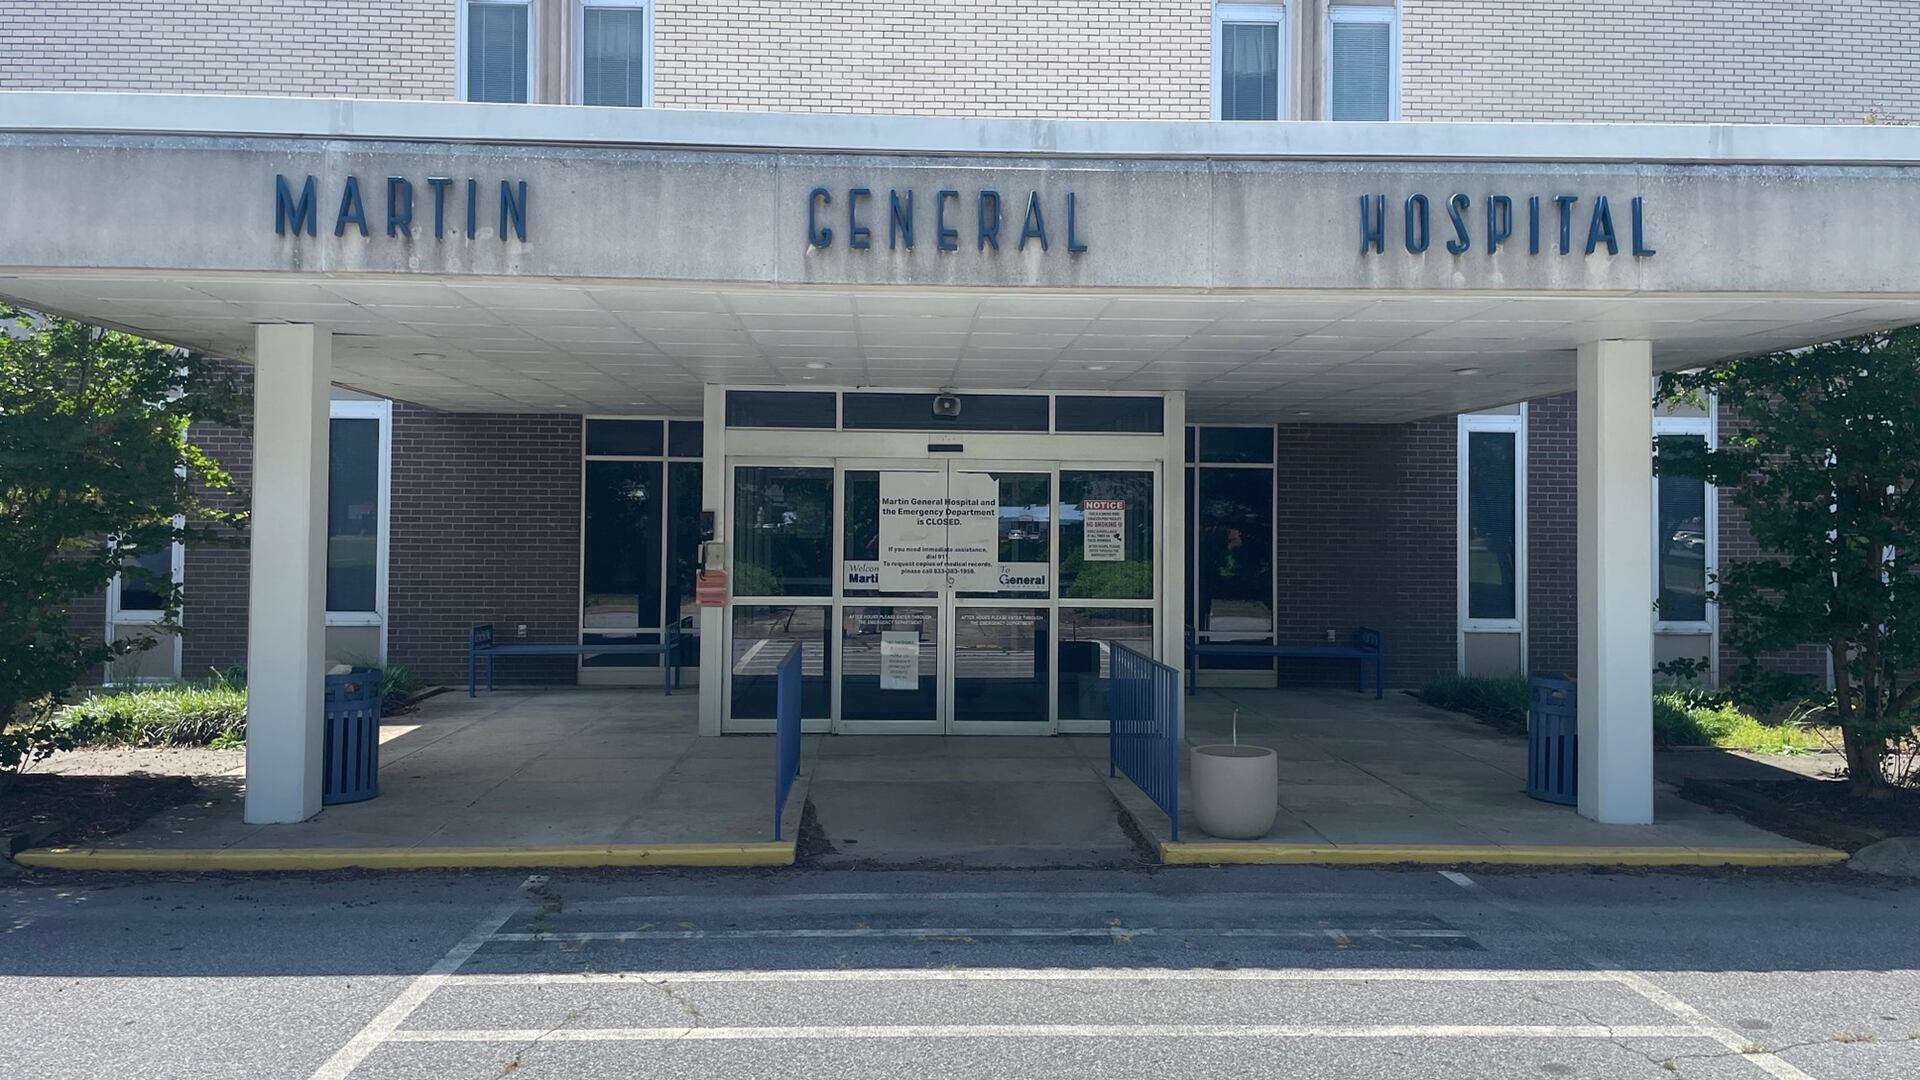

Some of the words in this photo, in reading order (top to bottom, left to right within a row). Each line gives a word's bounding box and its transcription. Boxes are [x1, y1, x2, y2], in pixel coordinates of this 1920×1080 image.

[275, 173, 527, 243] MARTIN
[808, 187, 1088, 253] GENERAL
[1360, 192, 1656, 256] HOSPITAL
[944, 499, 979, 507] Hospital
[898, 509, 943, 517] Emergency
[946, 509, 995, 517] Department
[850, 564, 879, 572] Welcom
[849, 573, 879, 583] Marti
[999, 574, 1045, 584] General
